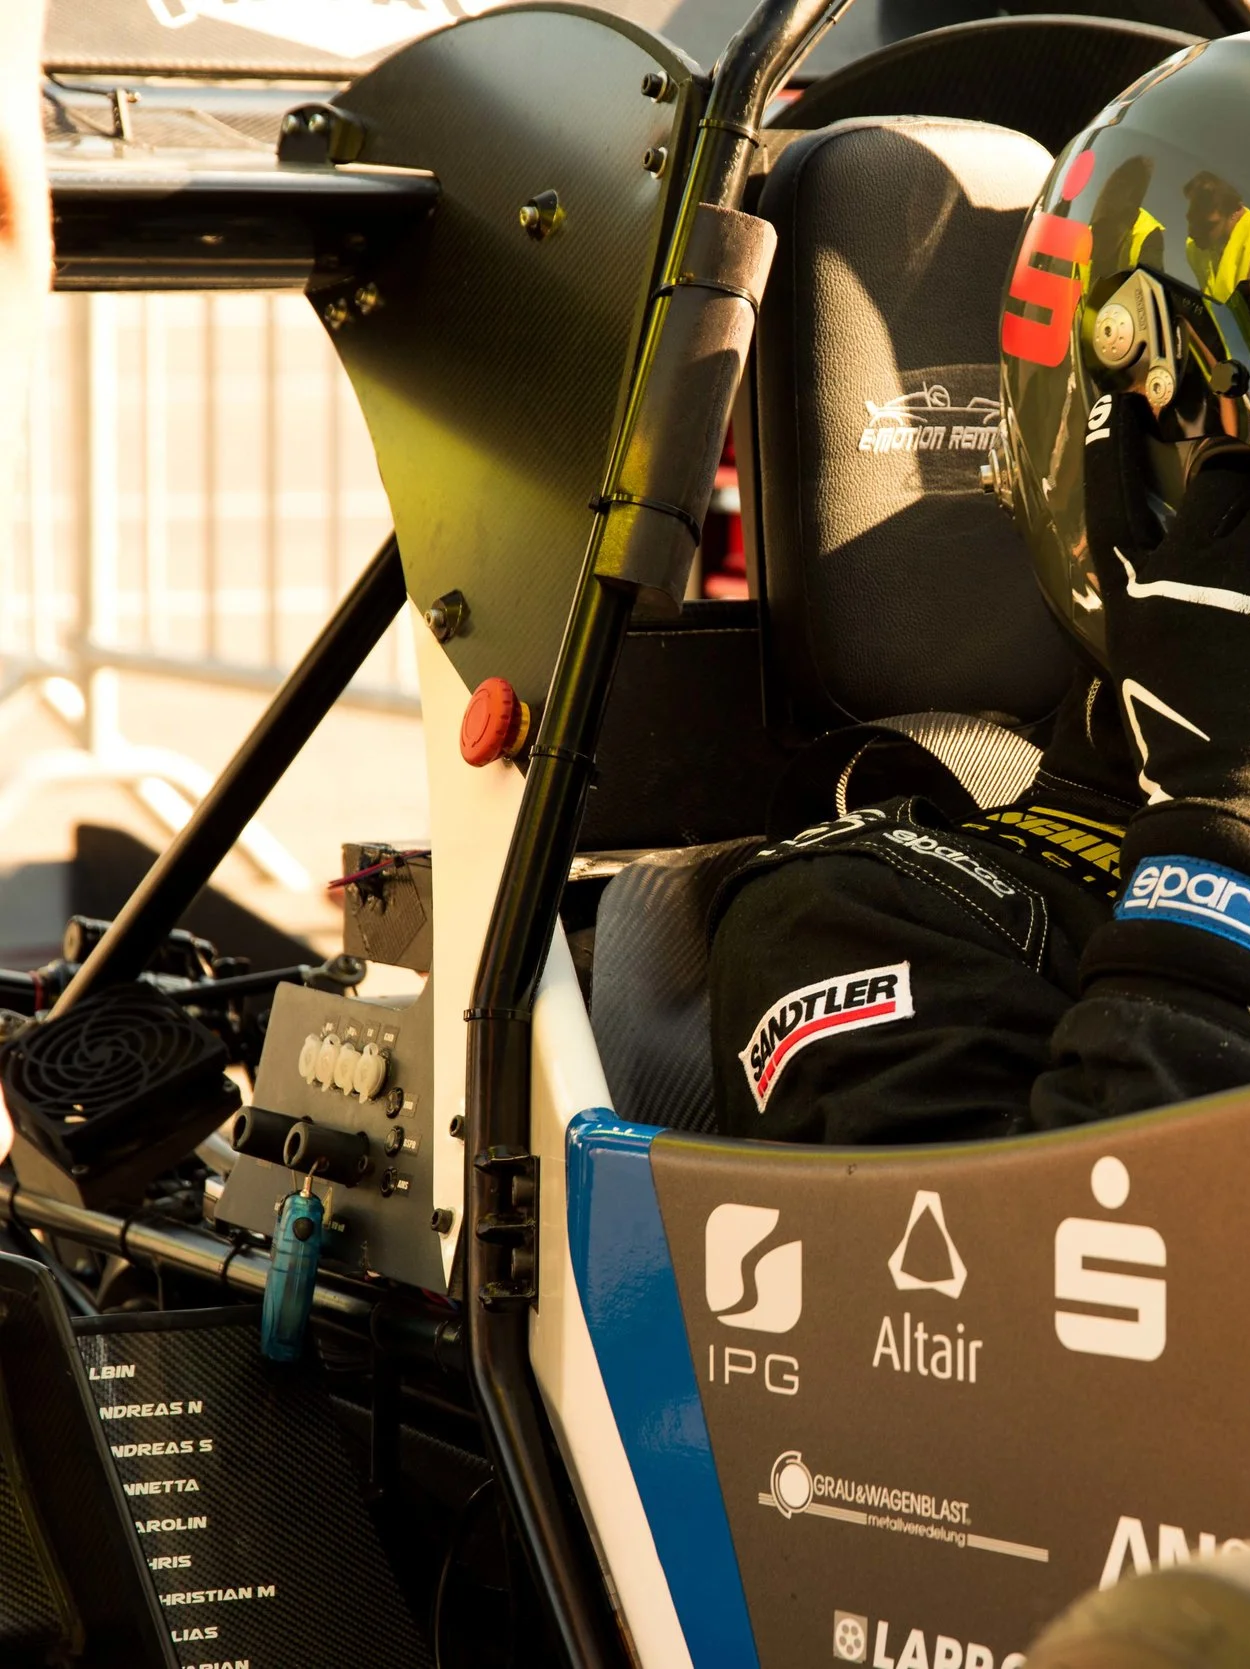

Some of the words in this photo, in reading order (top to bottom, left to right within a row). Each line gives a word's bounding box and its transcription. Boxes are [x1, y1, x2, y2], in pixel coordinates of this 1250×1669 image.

[948, 425, 999, 450] RENN
[750, 973, 898, 1082] SANDTLER
[872, 1311, 983, 1384] Altair
[89, 1364, 136, 1381] LBIN
[708, 1344, 800, 1396] IPG
[100, 1402, 183, 1420] NDREAS
[187, 1400, 203, 1415] N
[111, 1440, 194, 1458] NDREAS
[199, 1439, 213, 1453] S
[123, 1478, 200, 1496] NNETTA
[135, 1516, 207, 1534] AROLIN
[867, 1512, 967, 1549] metallveredelung
[147, 1555, 192, 1571] HRIS
[158, 1587, 252, 1607] HRISTIAN
[257, 1585, 275, 1598] M
[171, 1626, 219, 1643] LIAS
